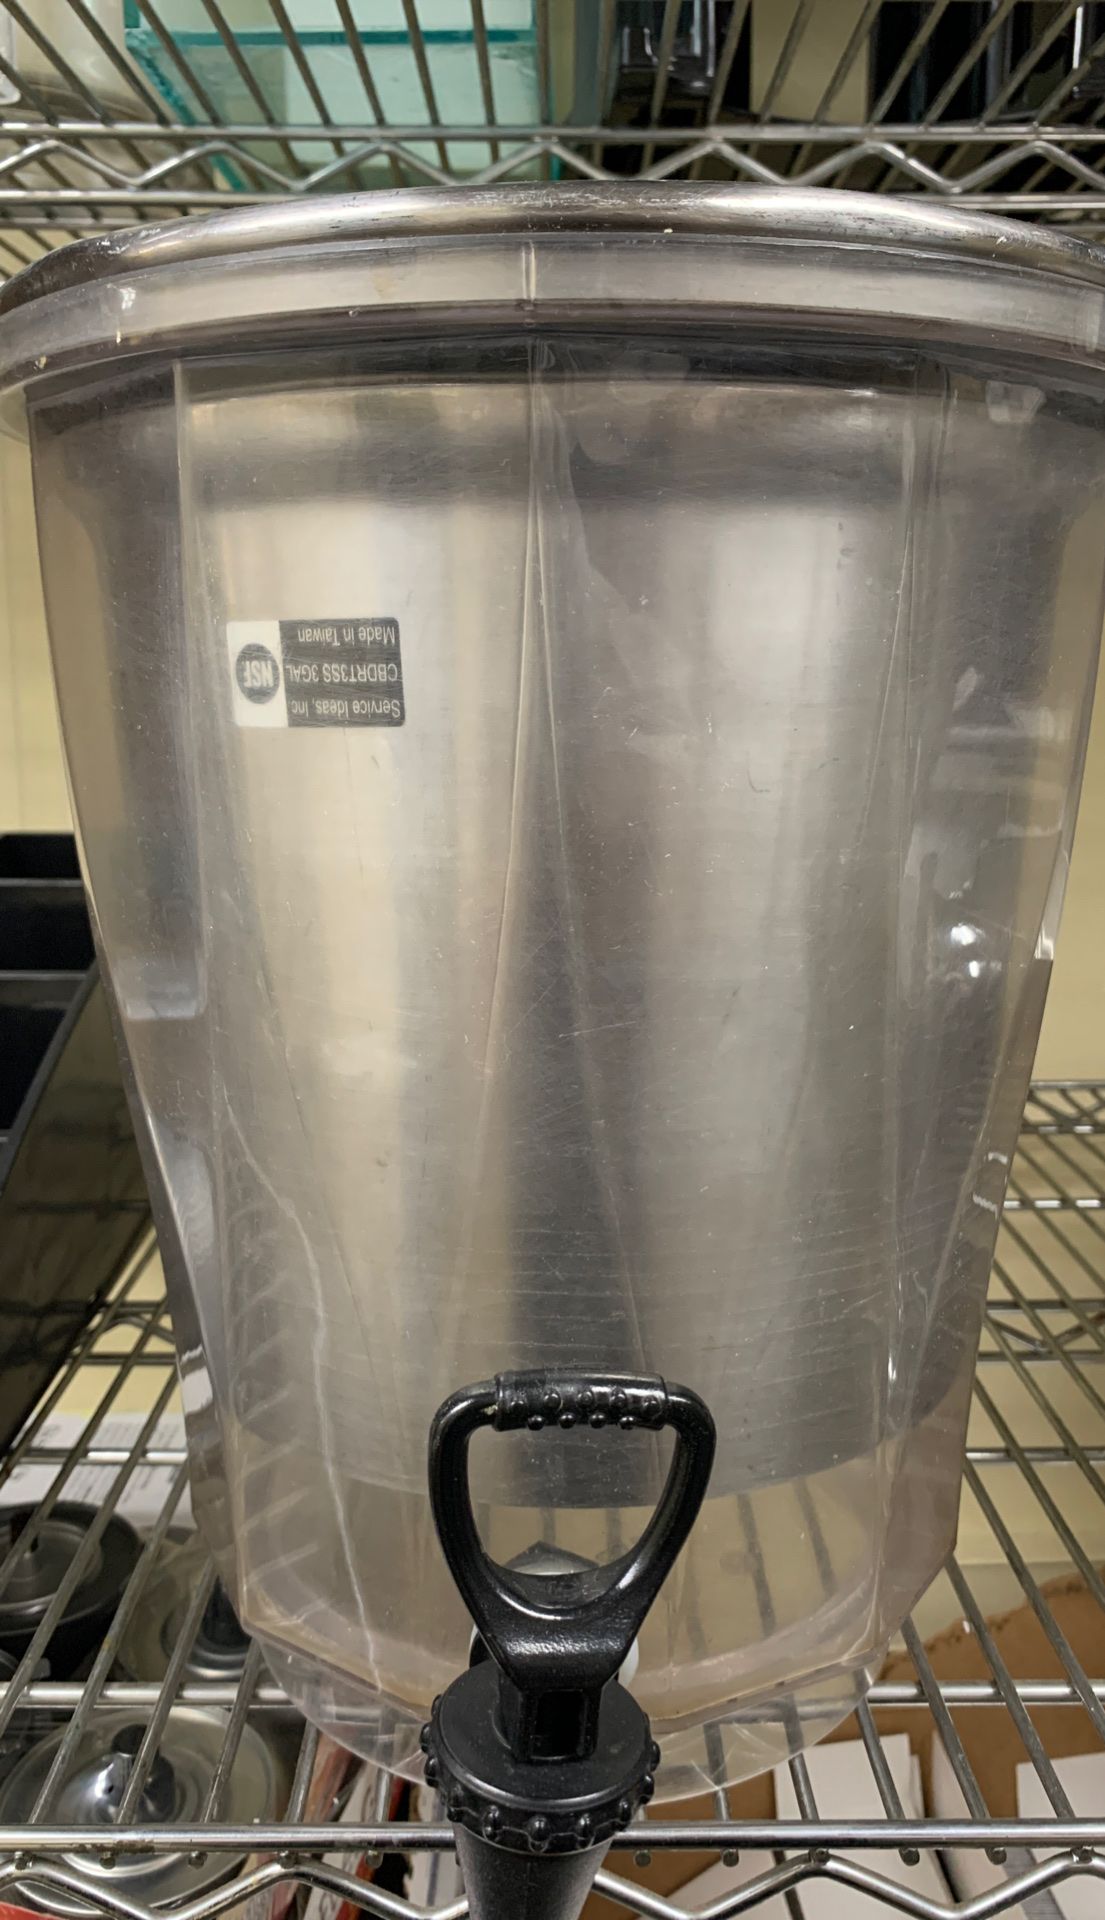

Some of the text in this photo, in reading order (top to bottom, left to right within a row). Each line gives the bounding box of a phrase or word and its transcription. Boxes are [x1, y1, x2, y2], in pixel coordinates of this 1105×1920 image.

[298, 626, 395, 646] Made in Taiwan
[243, 660, 274, 688] NSF
[285, 663, 398, 682] CBDRT3SS 3GAL
[312, 698, 349, 718] Ideas,
[352, 700, 401, 718] Service
